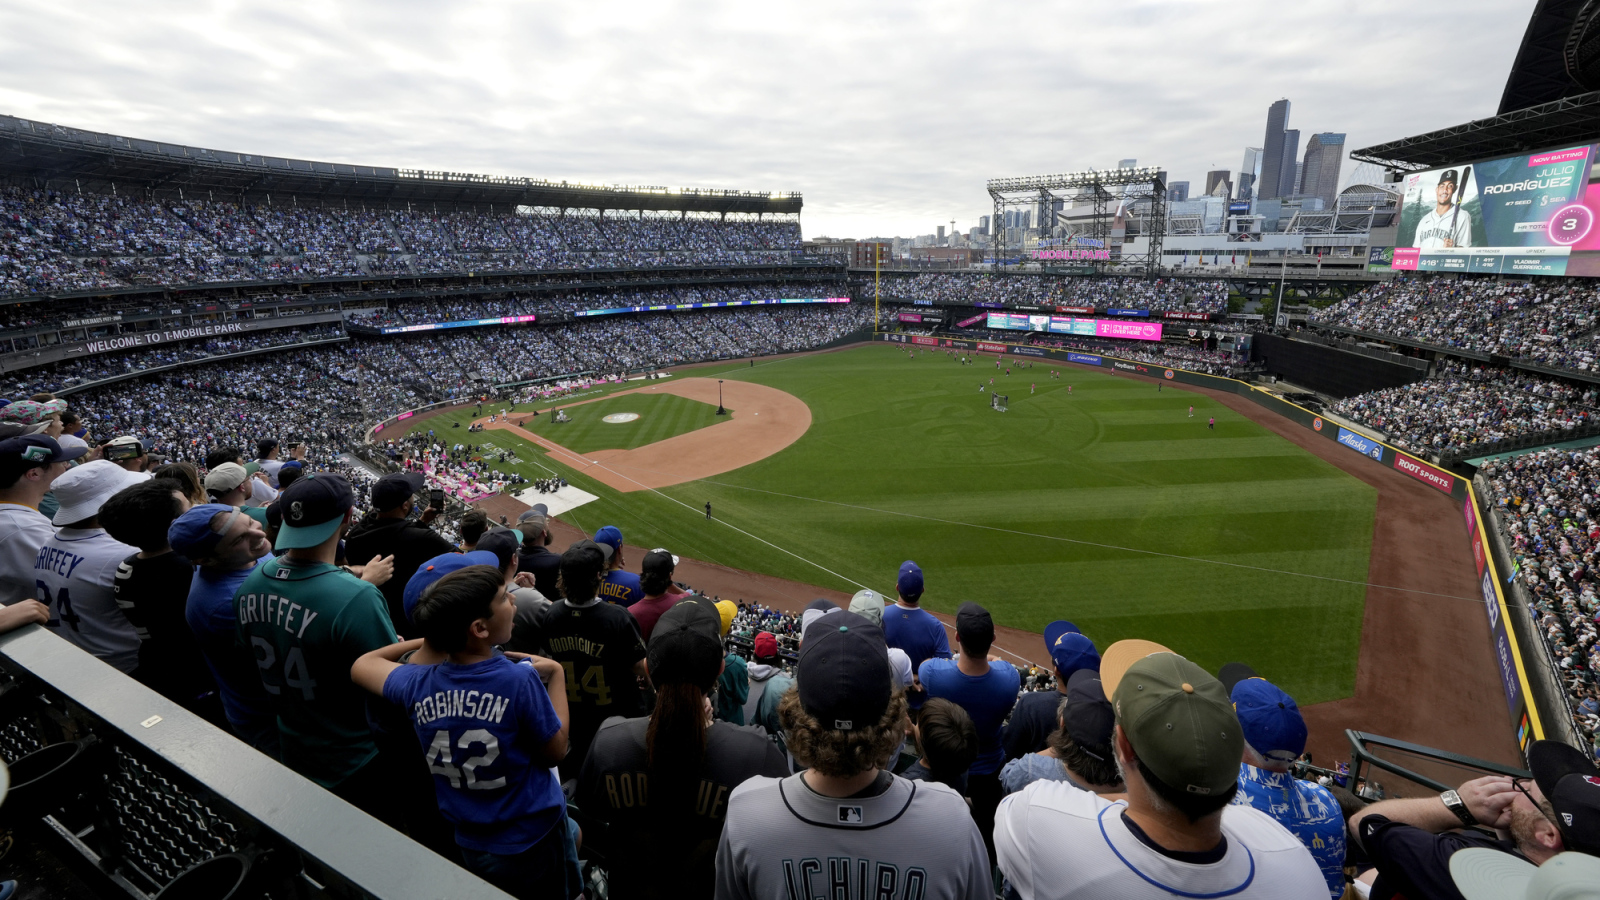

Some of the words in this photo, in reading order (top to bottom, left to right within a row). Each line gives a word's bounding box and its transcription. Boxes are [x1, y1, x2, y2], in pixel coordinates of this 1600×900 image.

[1550, 151, 1583, 161] BATTING
[1483, 176, 1572, 195] RODRÍGUEZ
[1536, 165, 1574, 178] JULIO
[1562, 218, 1577, 231] 3
[1031, 249, 1079, 260] T-MOBILE
[1080, 249, 1111, 260] PARK
[86, 336, 143, 353] WELCOME
[144, 332, 160, 343] TO
[163, 326, 213, 341] T-MOBILE
[214, 322, 243, 334] PARK
[1114, 361, 1136, 371] KeyBank
[1340, 433, 1367, 452] Alaska
[1398, 458, 1421, 474] ROOT
[1419, 469, 1449, 488] SPORTS
[34, 546, 84, 579] GRIFFEY
[1482, 571, 1499, 629] GEICO
[239, 593, 318, 640] GRIFFEY
[548, 633, 605, 659] RODRÍGUEZ
[250, 635, 317, 701] 24
[414, 689, 510, 726] ROBINSON
[426, 728, 507, 790] 42
[781, 856, 927, 900] ICHIRO
